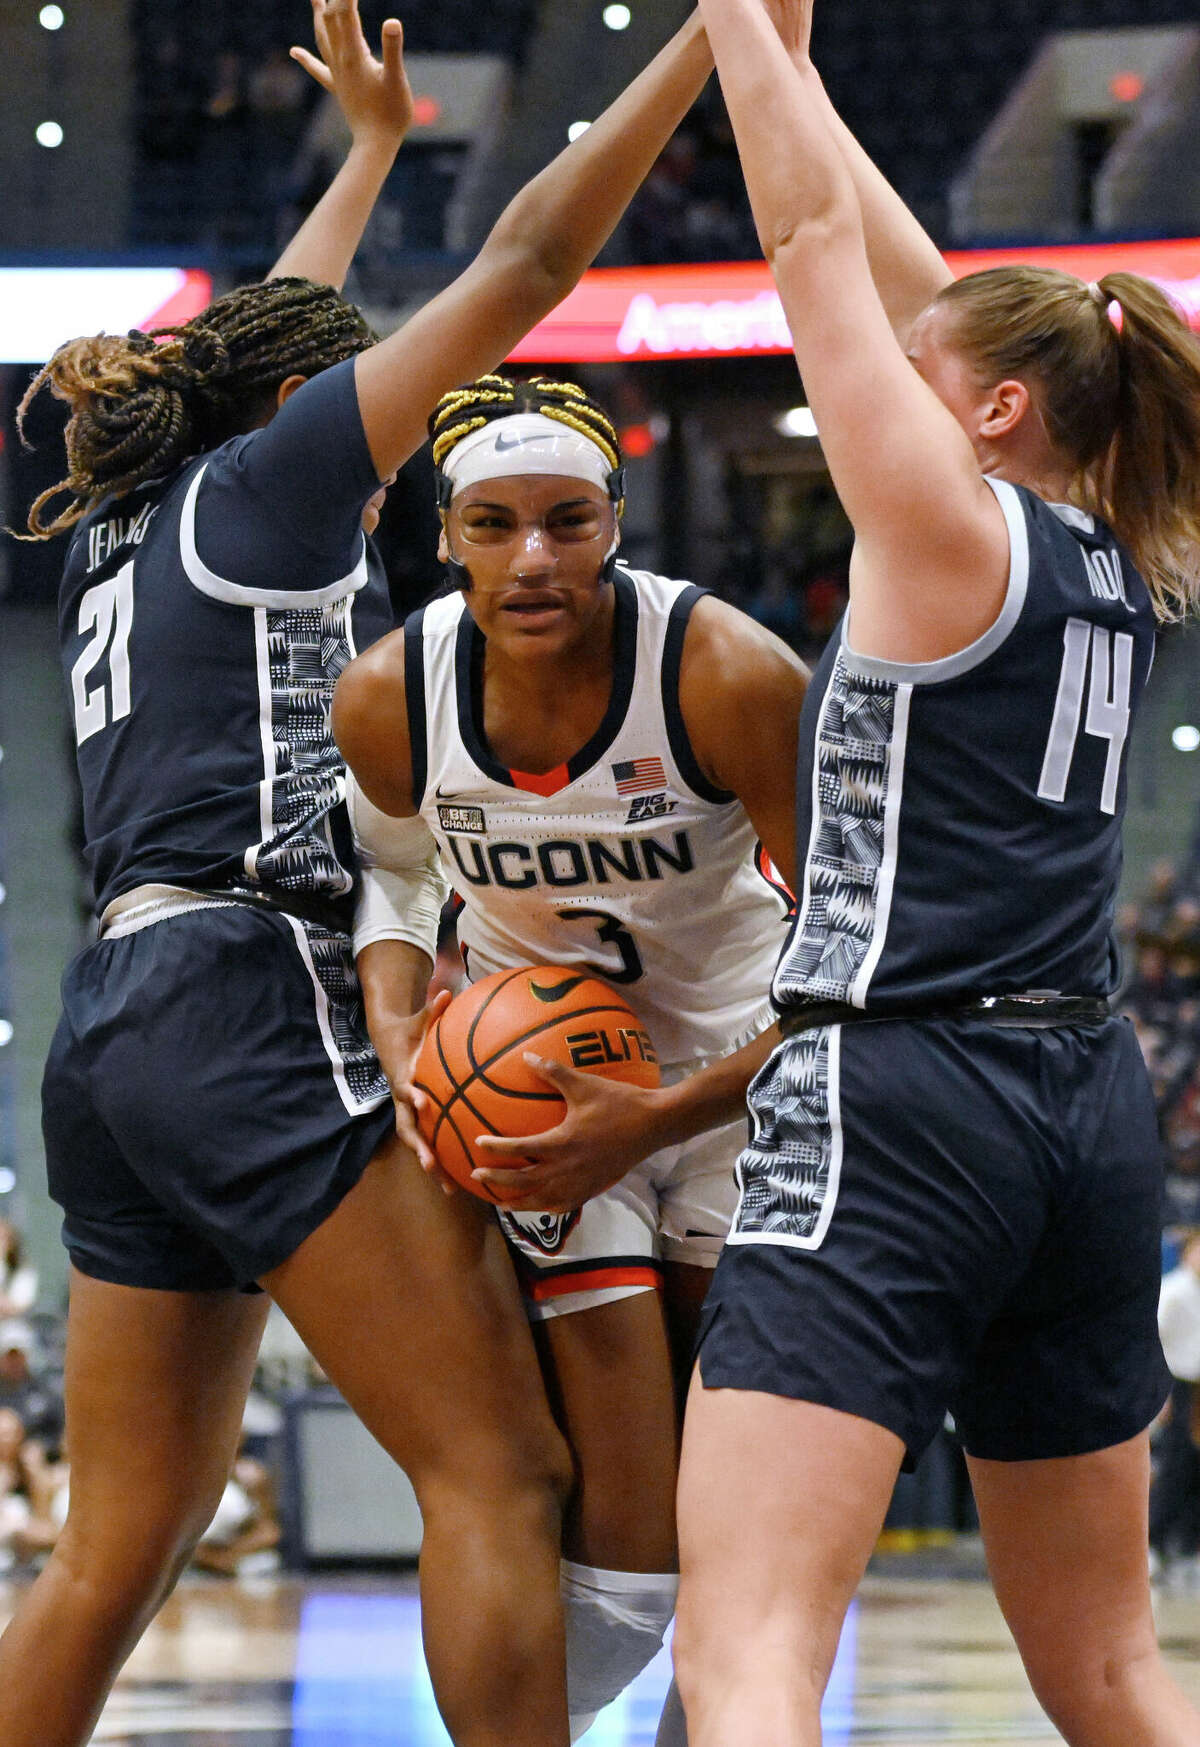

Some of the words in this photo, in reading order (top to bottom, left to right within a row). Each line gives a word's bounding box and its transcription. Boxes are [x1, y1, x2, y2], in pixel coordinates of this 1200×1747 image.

[71, 559, 135, 747] 21
[1037, 616, 1134, 816] 14
[442, 819, 484, 831] CHANGE
[628, 801, 679, 819] EAST
[631, 793, 666, 807] BIG
[447, 829, 694, 889] UCONN
[556, 909, 643, 984] 3
[565, 1028, 656, 1068] ELITE
